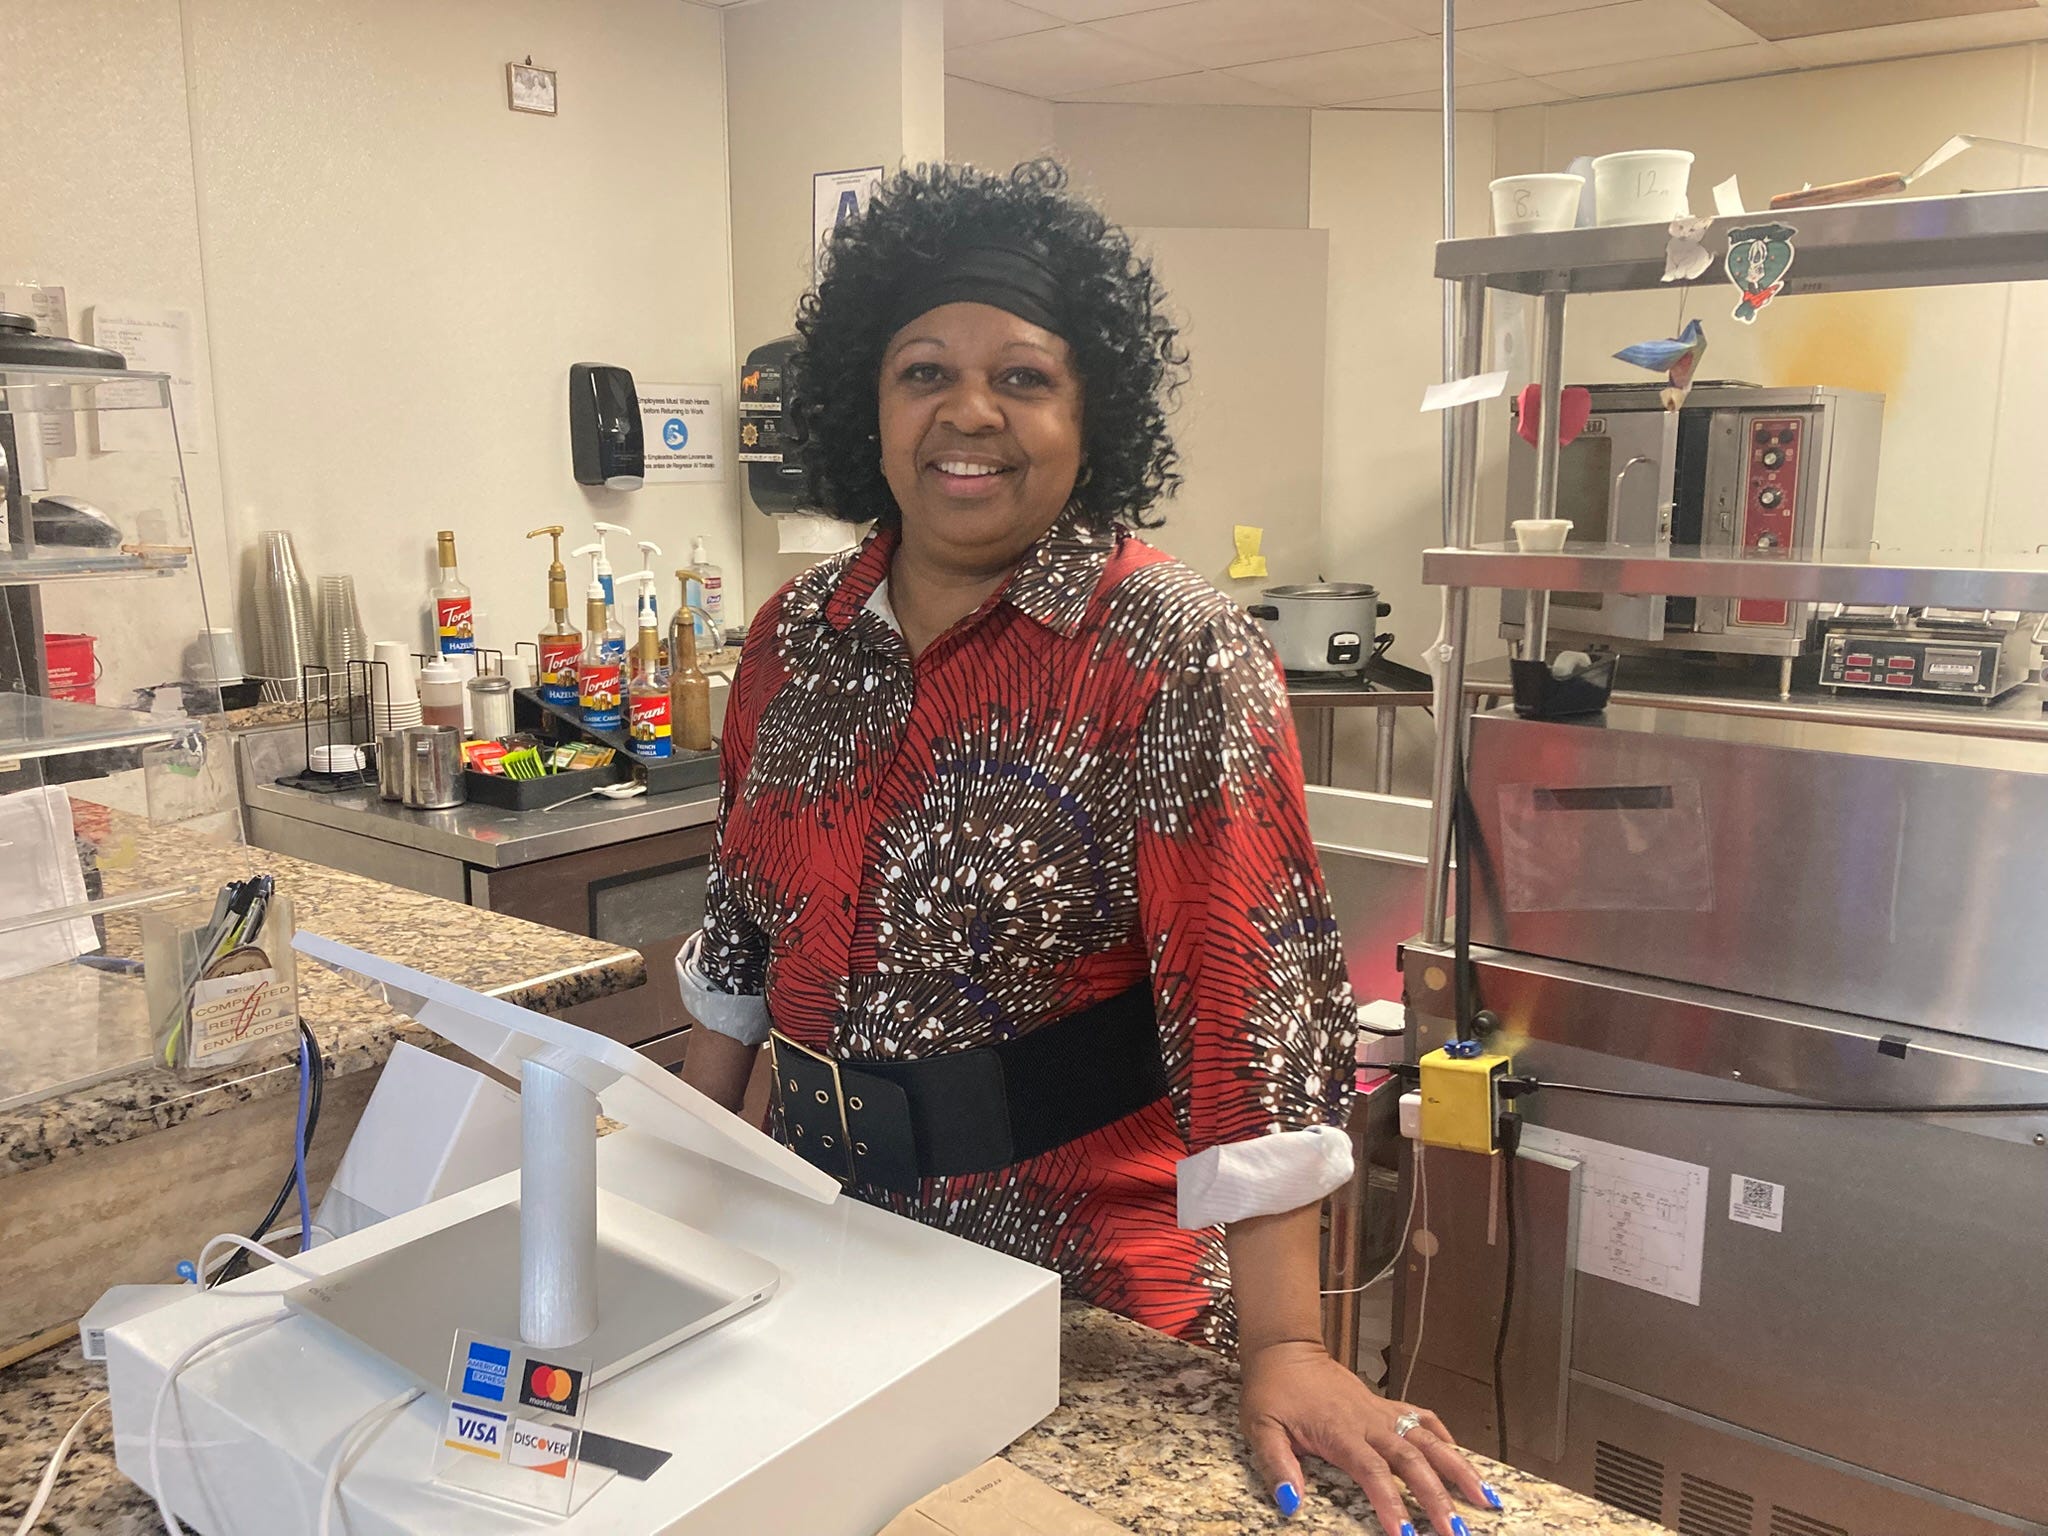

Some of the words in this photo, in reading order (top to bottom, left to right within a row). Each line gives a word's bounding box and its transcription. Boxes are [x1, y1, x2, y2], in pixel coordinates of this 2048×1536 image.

[442, 604, 472, 627] Tora
[549, 690, 579, 699] HAZELN
[629, 702, 667, 727] Torani
[456, 1415, 498, 1446] VISA
[513, 1431, 570, 1457] DISCOVER
